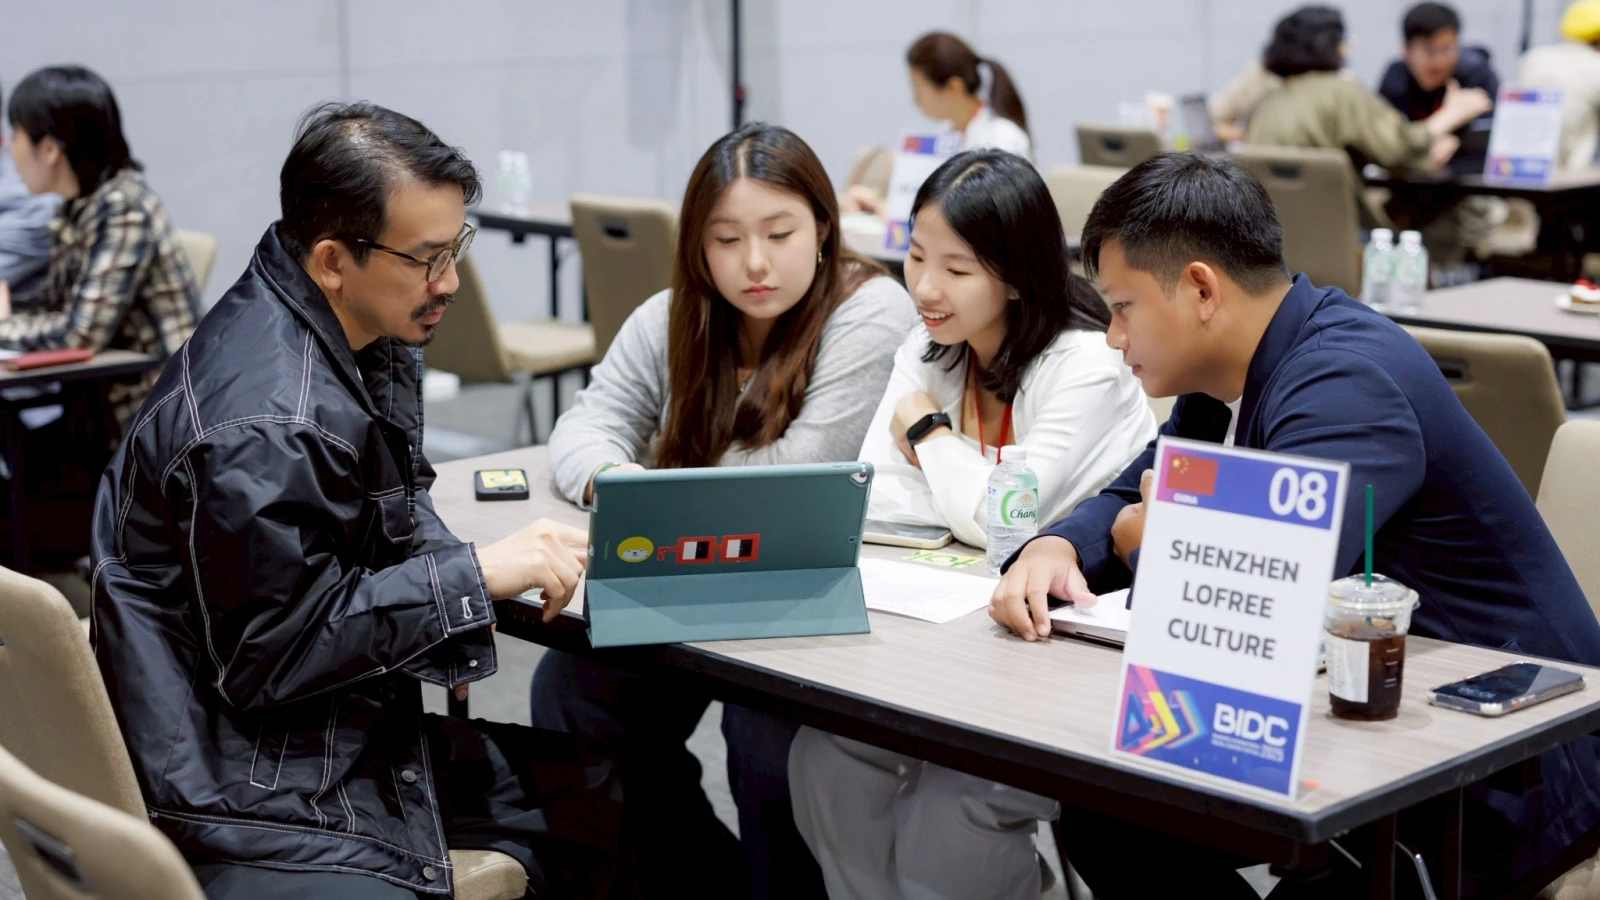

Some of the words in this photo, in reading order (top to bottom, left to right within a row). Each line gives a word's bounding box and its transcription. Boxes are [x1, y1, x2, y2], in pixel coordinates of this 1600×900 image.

[1269, 467, 1328, 521] 08
[1170, 539, 1299, 583] SHENZHEN
[1182, 581, 1275, 619] LOFREE
[1167, 618, 1277, 660] CULTURE
[1213, 702, 1290, 748] BIDC
